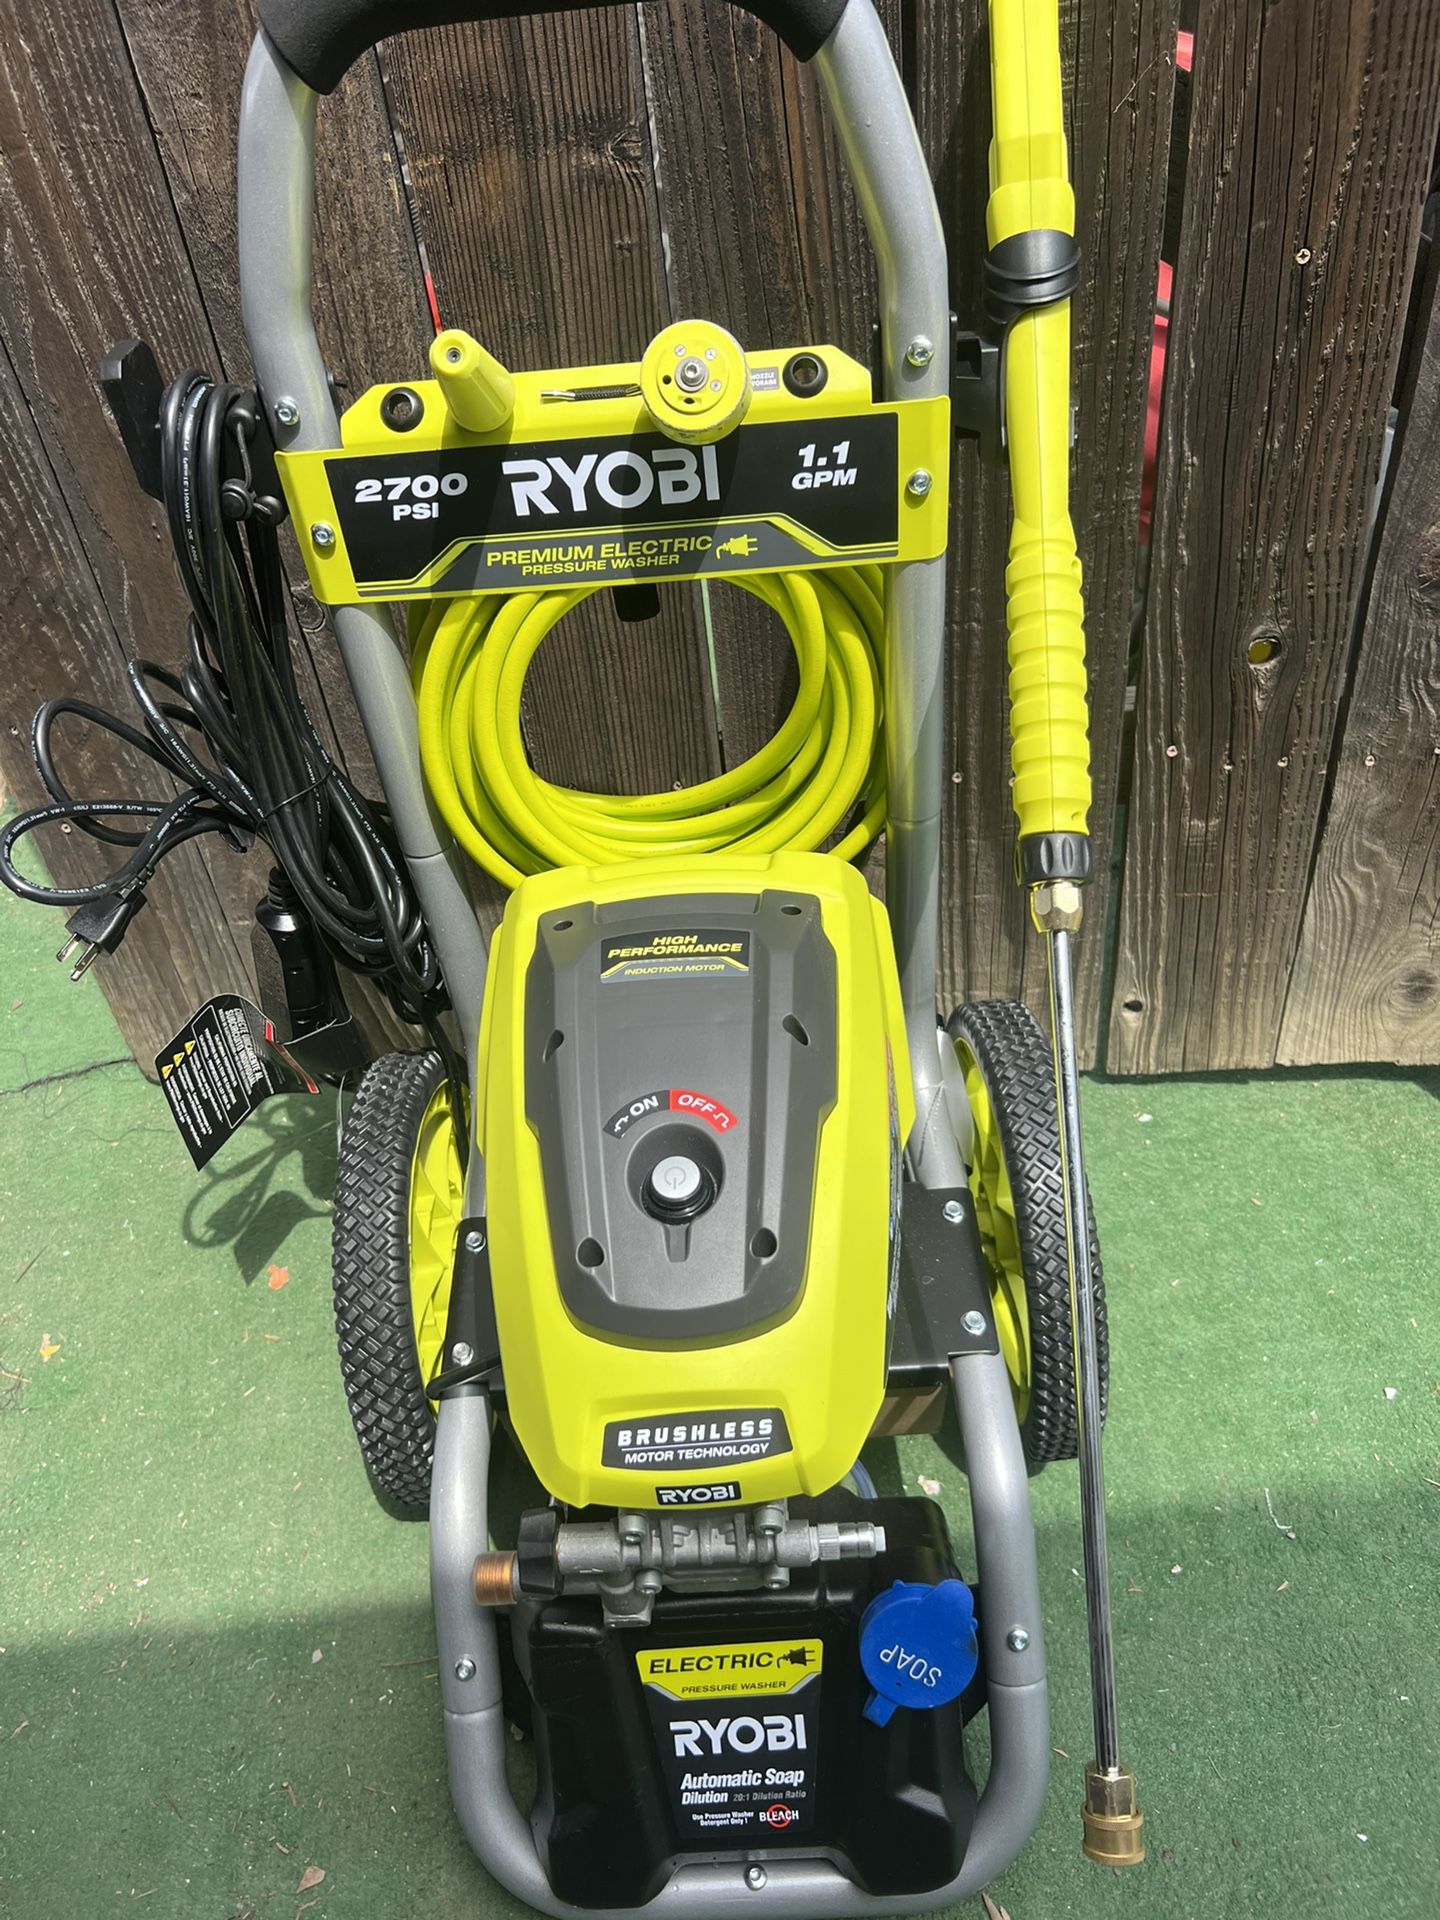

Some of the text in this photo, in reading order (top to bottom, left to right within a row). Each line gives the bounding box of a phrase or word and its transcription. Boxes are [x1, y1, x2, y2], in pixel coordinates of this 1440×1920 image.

[751, 378, 777, 387] TORAGE
[798, 441, 850, 467] 1.1
[355, 473, 469, 502] 2700
[501, 445, 721, 517] RYOBI
[791, 468, 858, 490] GPM
[393, 502, 439, 521] PSI
[486, 536, 713, 567] PREMIUM ELECTRIC
[521, 554, 680, 577] PRESSURE WASHER
[607, 943, 743, 958] PERFORMANCE
[652, 935, 698, 946] HIGH
[624, 964, 725, 976] INDUCTION MOTOR
[630, 1094, 716, 1116] ON OFF
[618, 1419, 773, 1447] BRUSHLESS
[625, 1443, 769, 1464] MOTOR TECHNOLOGY
[659, 1485, 735, 1503] RYOBI
[649, 1652, 773, 1674] ELECTRIC
[880, 1644, 942, 1687] SOAP
[682, 1681, 786, 1694] PRESSURE WASHER
[669, 1714, 807, 1757] RYOBI
[680, 1768, 805, 1790] Automatic Soap
[681, 1789, 807, 1805] Dilution 20:1 Dilution Ratio
[692, 1813, 703, 1821] Use
[700, 1819, 730, 1827] Detergent
[759, 1810, 800, 1822] BLEACH
